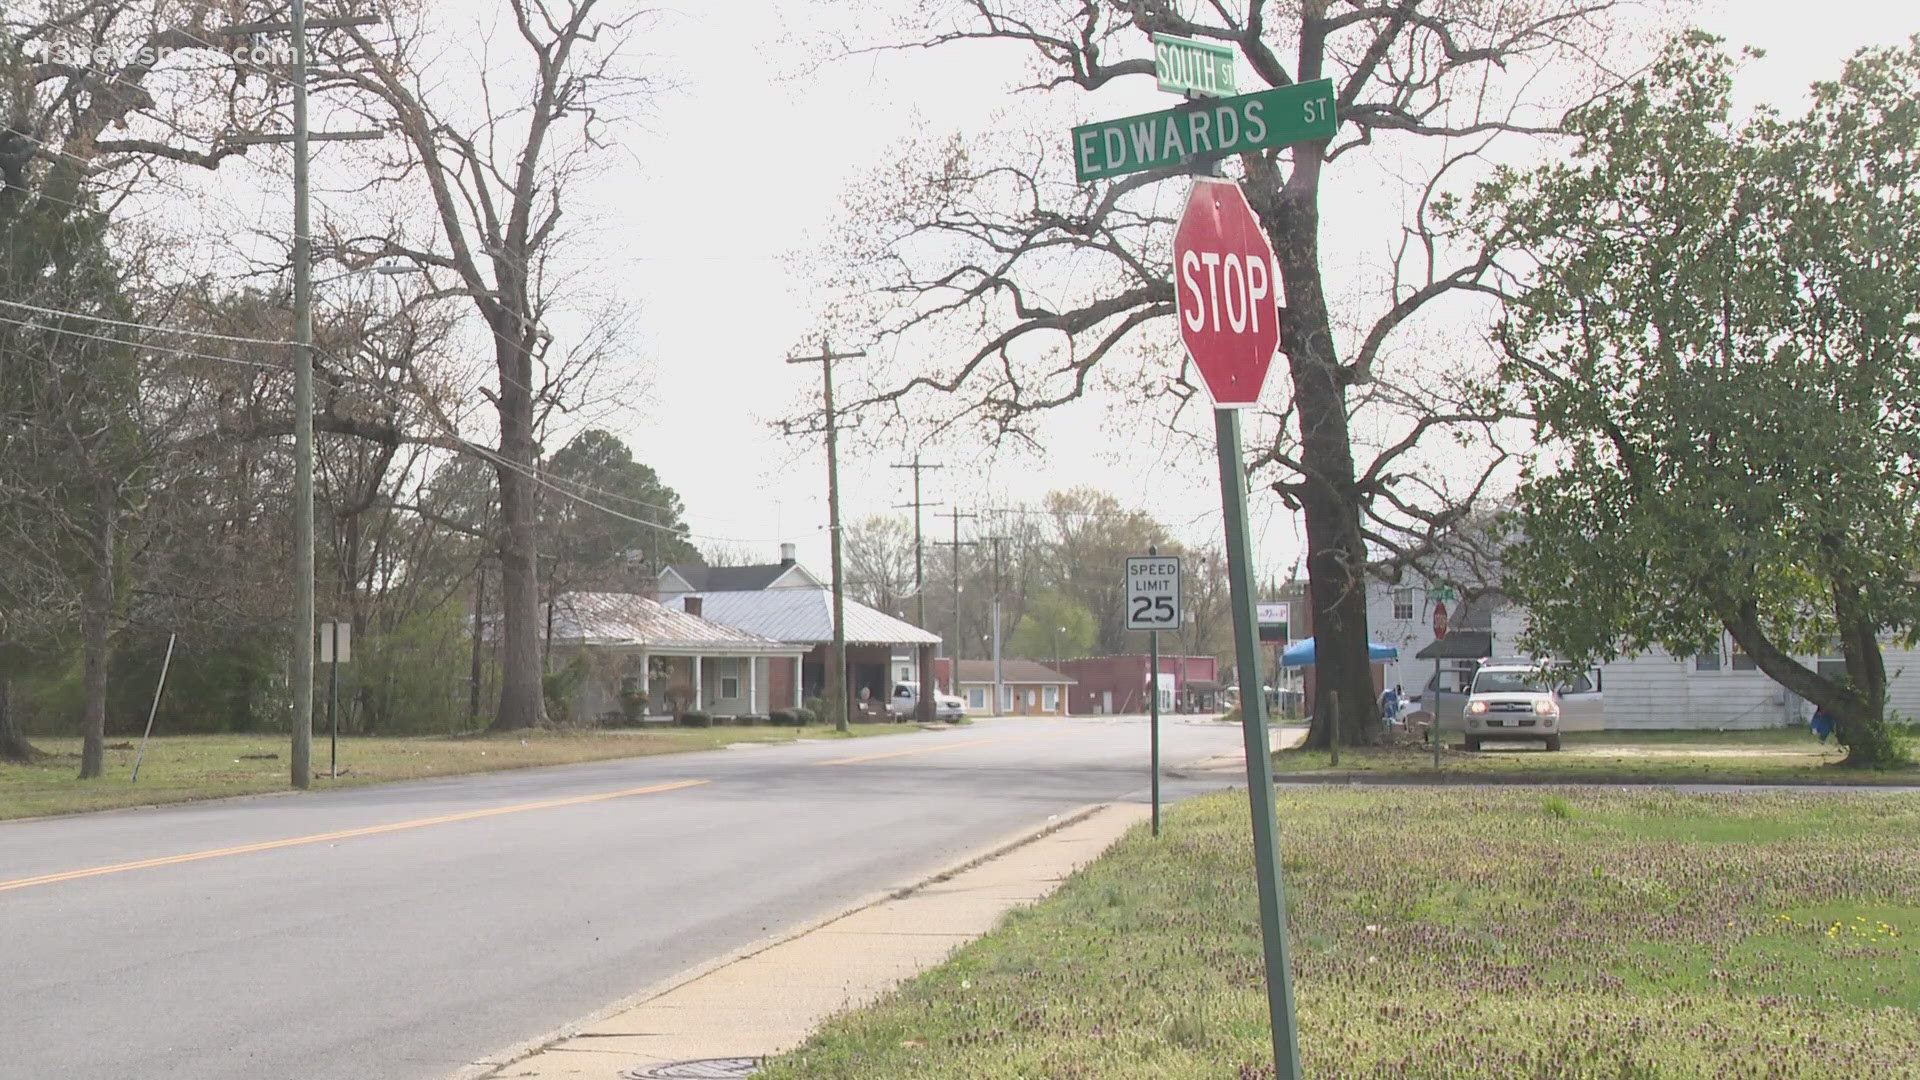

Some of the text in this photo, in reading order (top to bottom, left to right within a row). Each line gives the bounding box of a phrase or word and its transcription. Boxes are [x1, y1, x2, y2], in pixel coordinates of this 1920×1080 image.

[1157, 42, 1234, 91] SOUTH ST
[1079, 97, 1327, 174] EDWARDS ST
[1182, 249, 1268, 334] STOP
[1130, 564, 1176, 576] SPEED
[1135, 580, 1170, 592] LIMIT
[1132, 596, 1175, 623] 25
